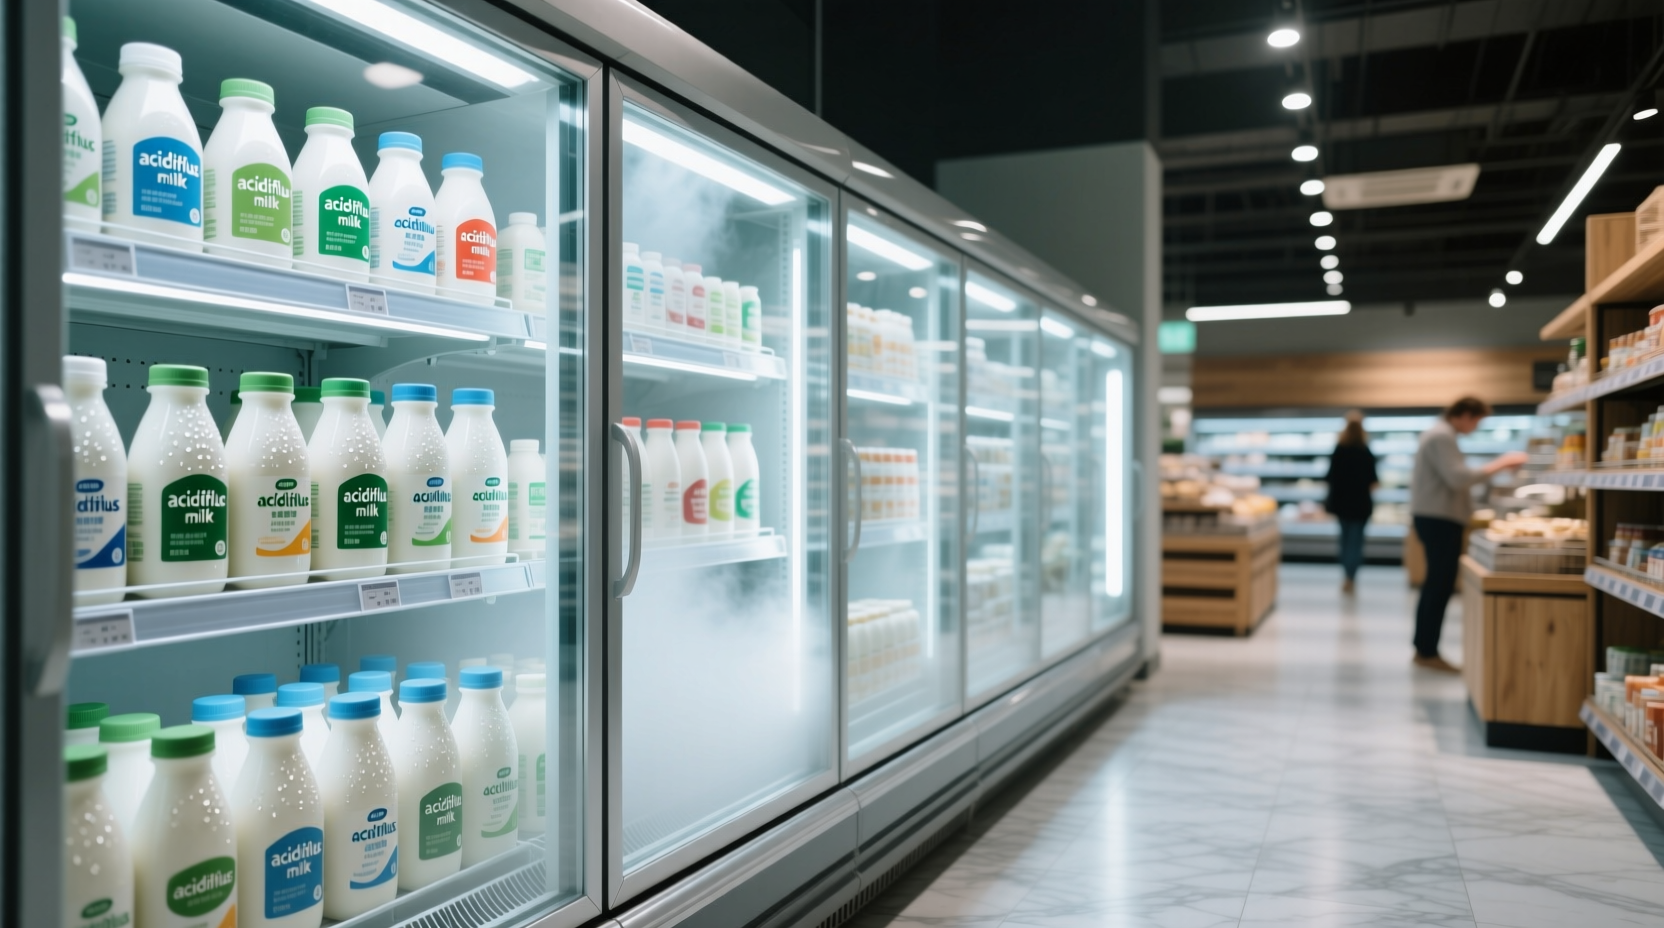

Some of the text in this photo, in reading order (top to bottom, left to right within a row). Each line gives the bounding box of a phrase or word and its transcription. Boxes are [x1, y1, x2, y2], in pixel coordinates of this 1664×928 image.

[157, 172, 188, 190] milk
[254, 195, 280, 210] milk
[338, 215, 362, 229] milk
[184, 508, 215, 525] milk
[355, 503, 380, 518] milk
[286, 859, 313, 880] milk
